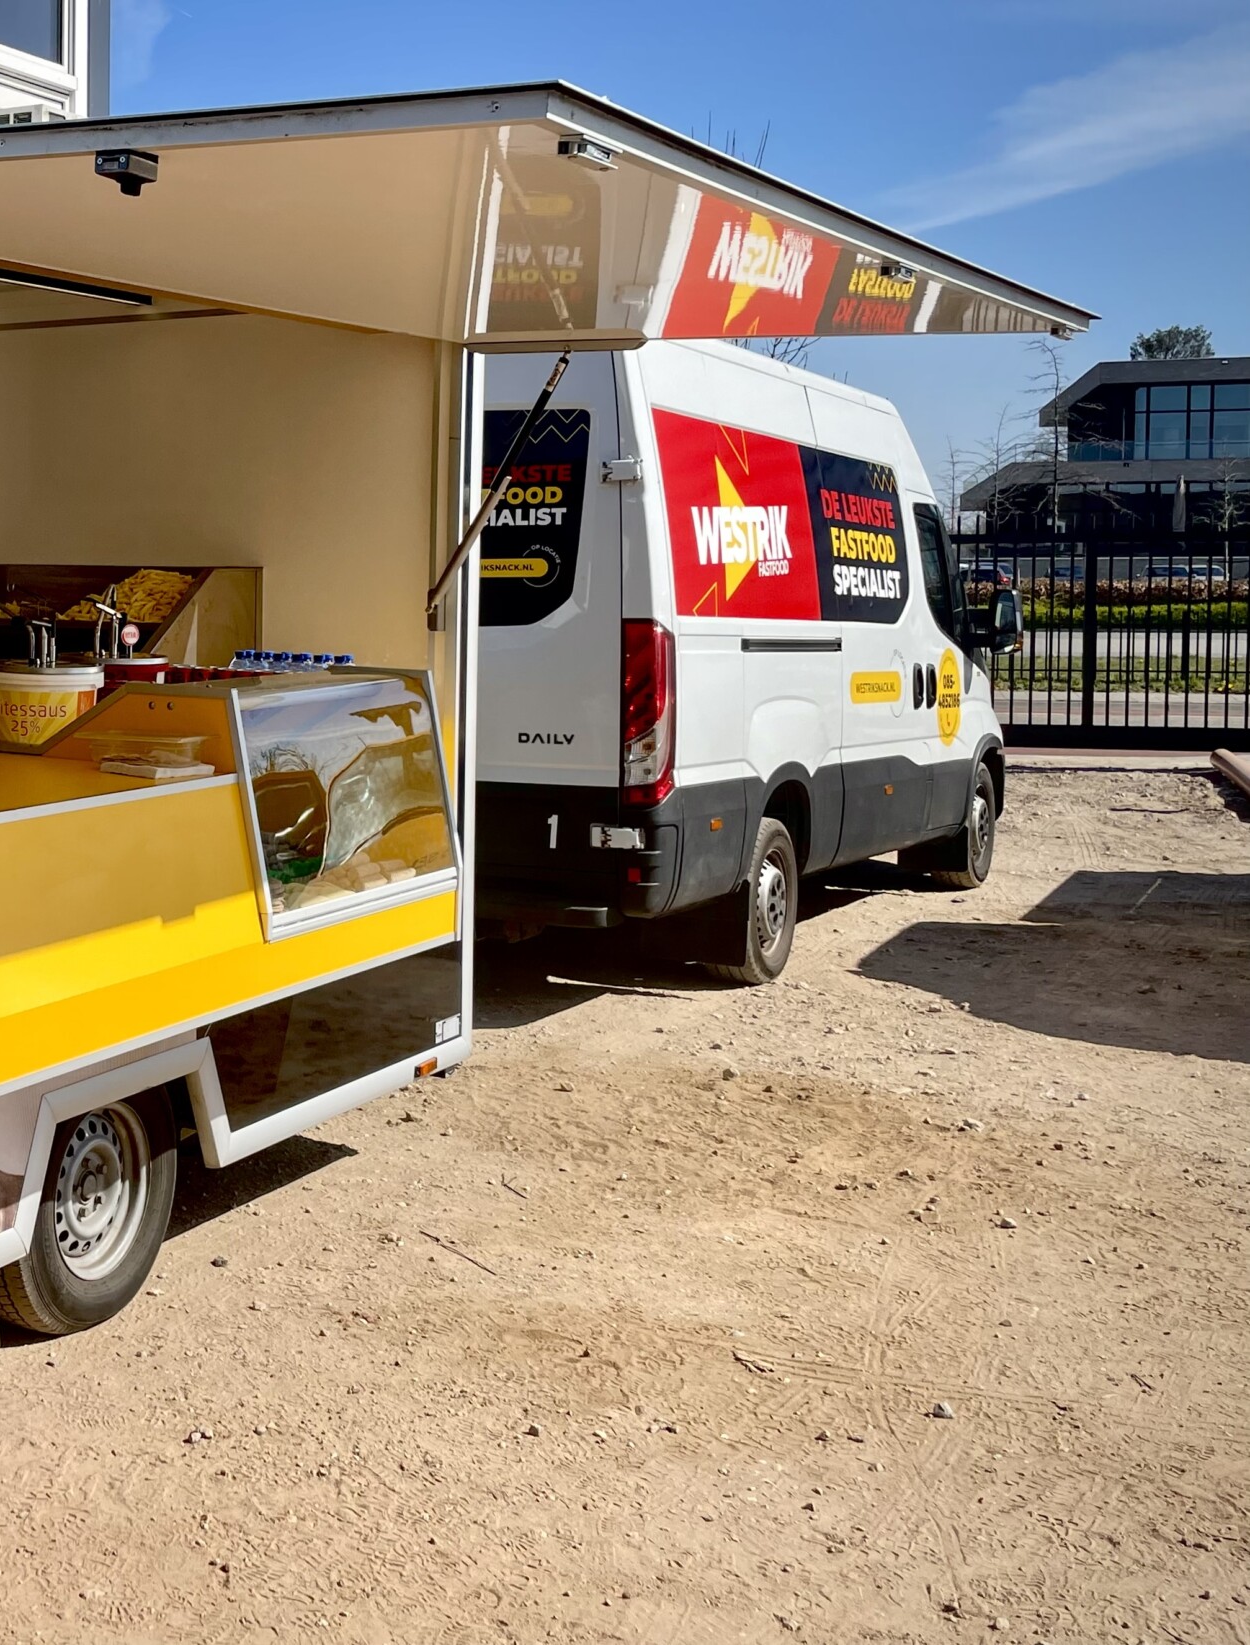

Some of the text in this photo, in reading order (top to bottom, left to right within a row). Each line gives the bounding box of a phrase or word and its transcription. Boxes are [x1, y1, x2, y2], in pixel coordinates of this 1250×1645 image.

[820, 488, 896, 530] DE LEUKSTE
[690, 505, 793, 566] WESTRIK
[830, 526, 896, 564] FASTFOOD
[758, 560, 790, 578] FASTFOOD
[832, 564, 901, 599] SPECIALIST
[11, 719, 41, 737] 25%
[518, 732, 575, 745] DAILY
[547, 814, 559, 849] 1
